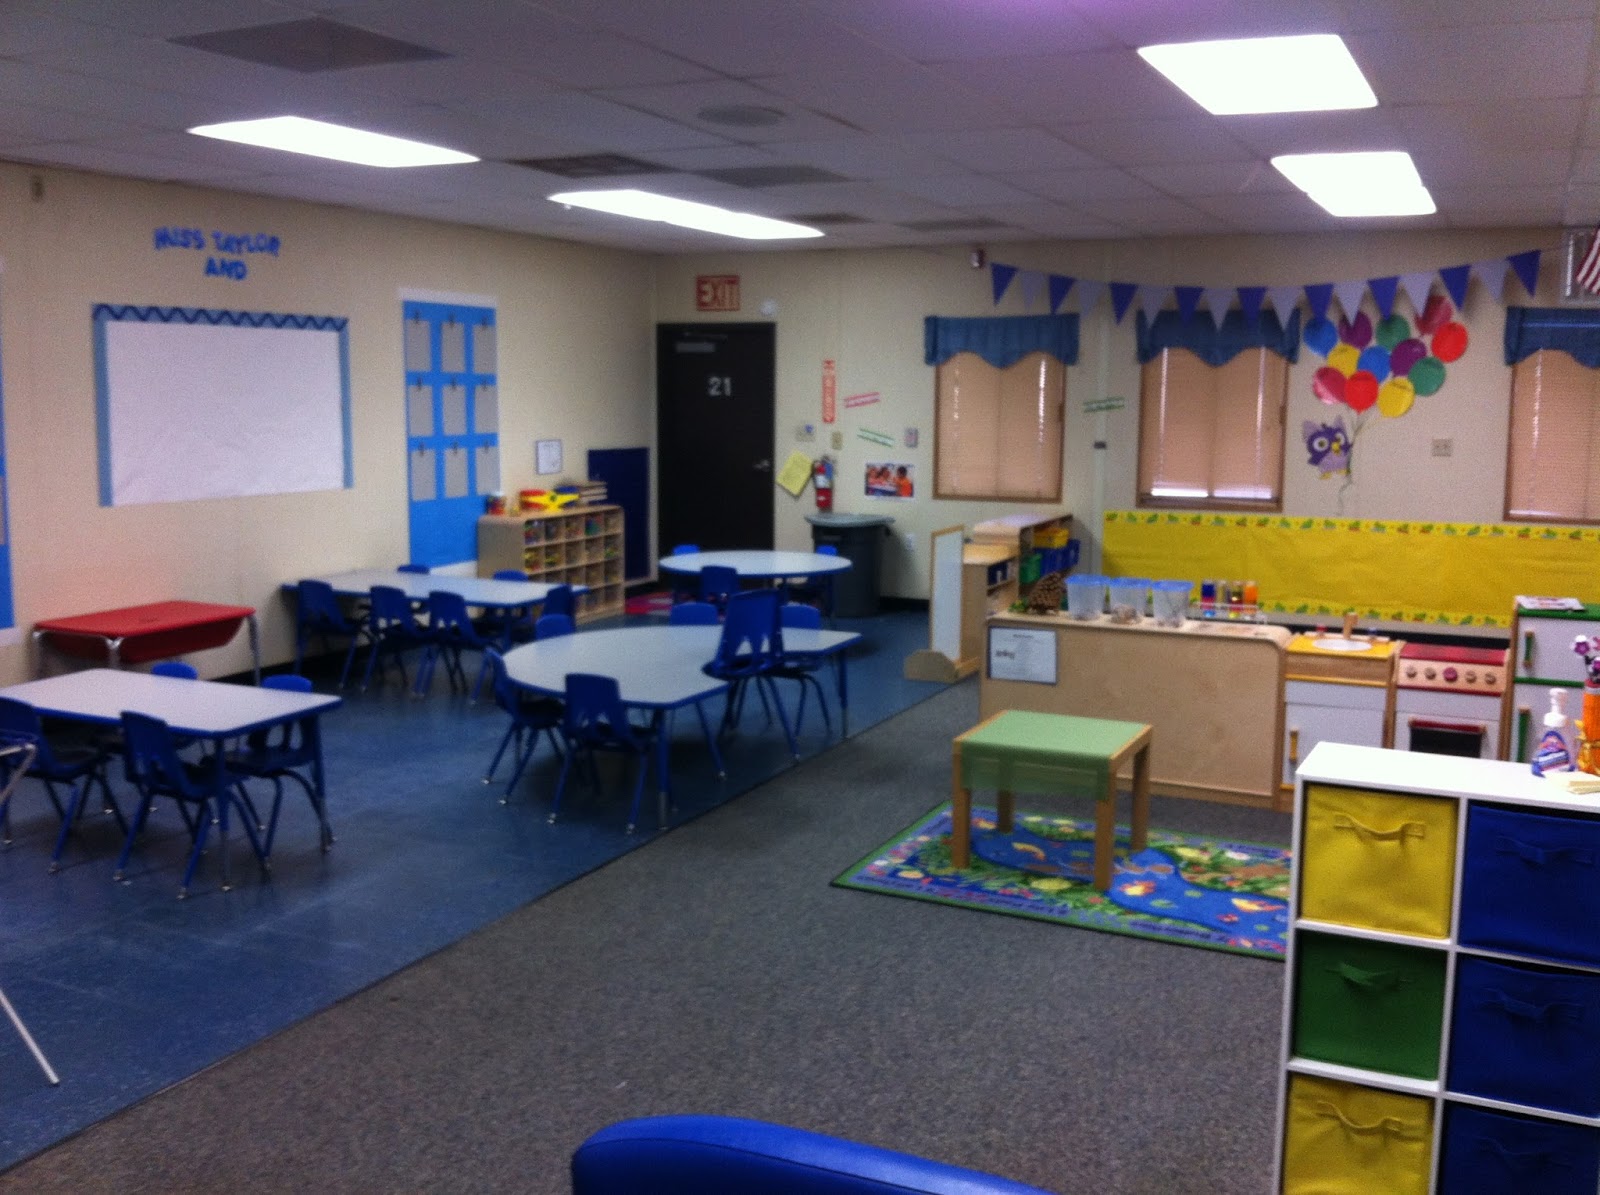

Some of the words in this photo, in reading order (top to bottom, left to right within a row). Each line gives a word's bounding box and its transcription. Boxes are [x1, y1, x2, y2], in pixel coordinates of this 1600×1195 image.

[153, 226, 206, 250] MISS
[211, 230, 281, 257] TAYLOR
[205, 256, 247, 280] AND
[697, 278, 739, 308] EXIT
[709, 376, 731, 397] 21
